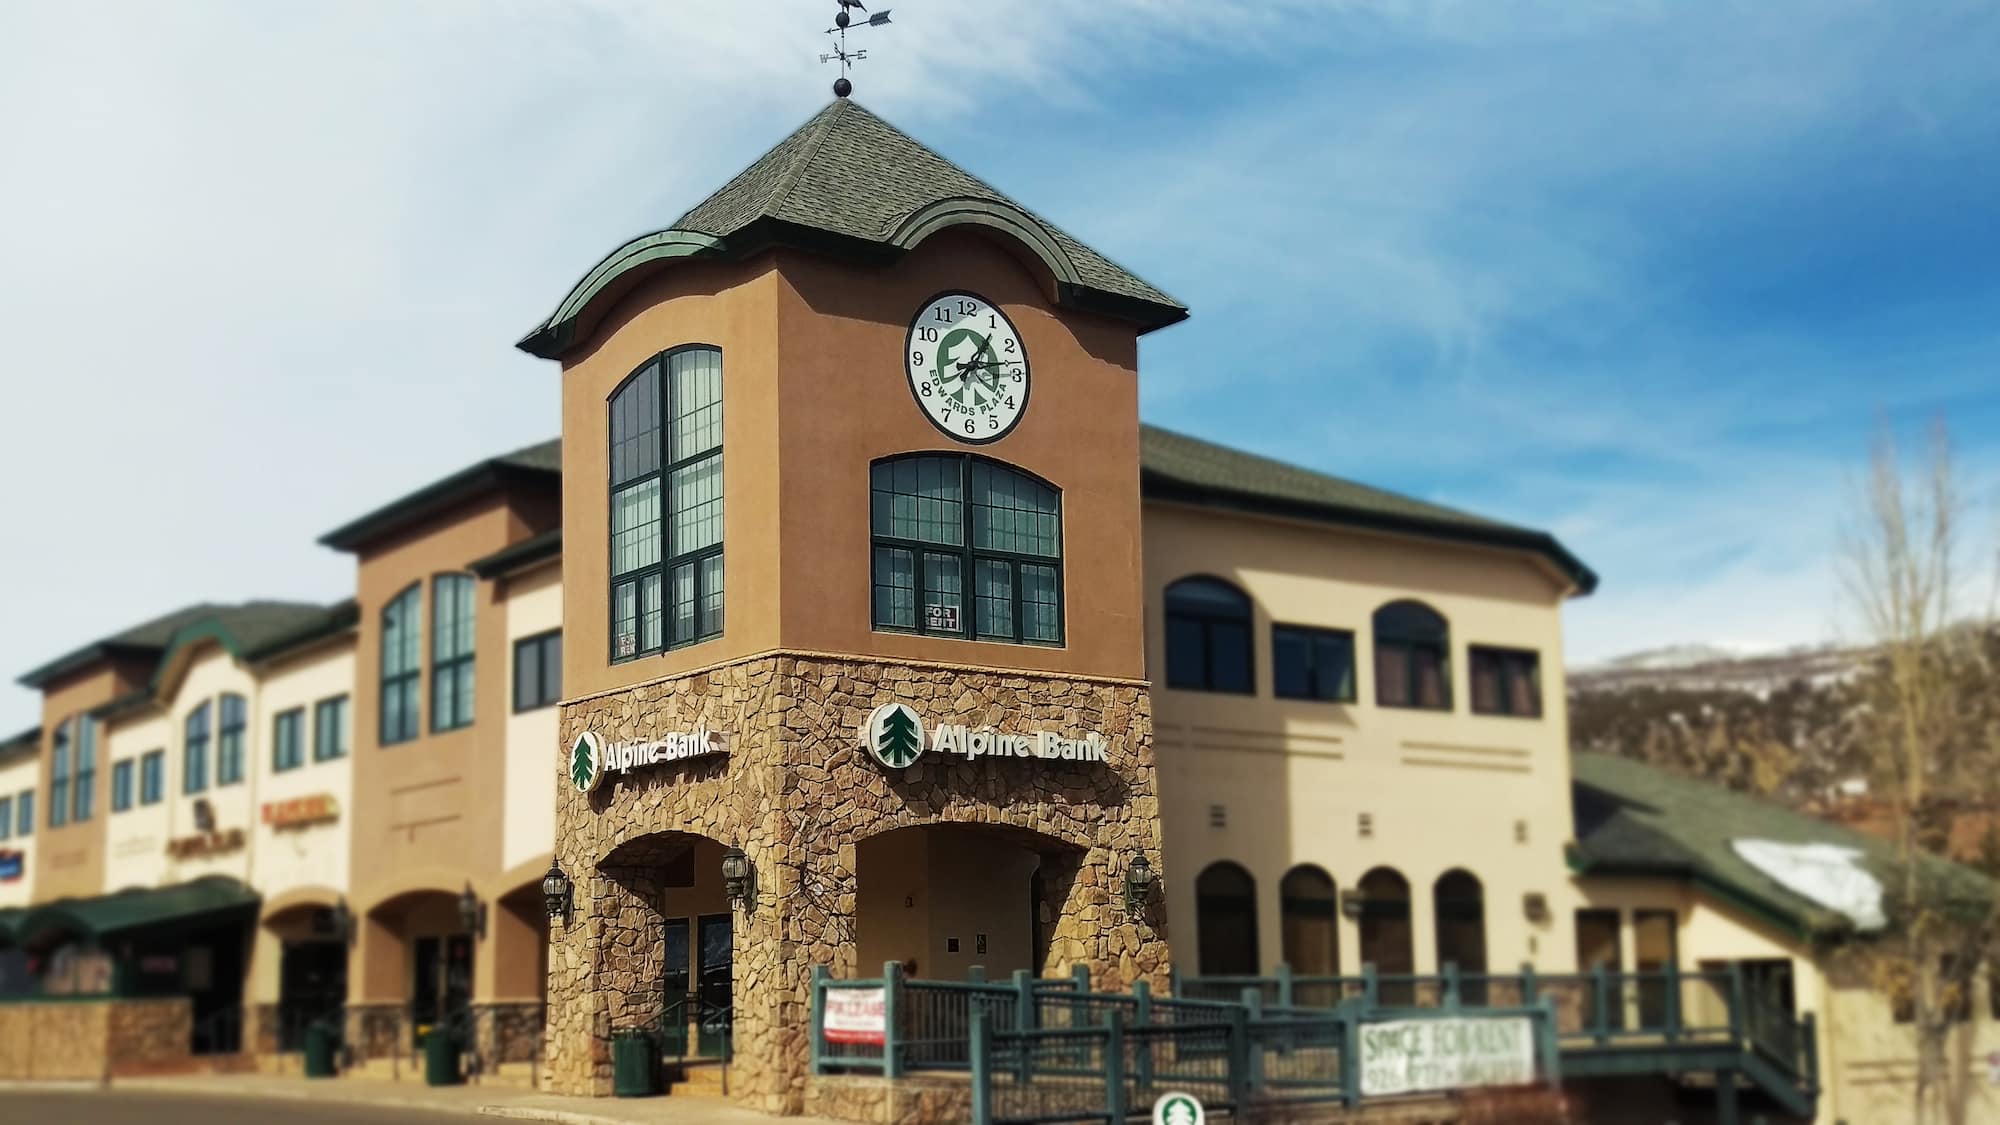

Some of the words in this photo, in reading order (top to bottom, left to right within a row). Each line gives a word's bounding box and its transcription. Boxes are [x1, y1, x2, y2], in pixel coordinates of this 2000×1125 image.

[857, 49, 867, 60] E
[934, 306, 953, 323] 11
[957, 300, 977, 316] 12
[988, 314, 997, 329] 1
[918, 326, 938, 343] 10
[1004, 338, 1015, 353] 2
[912, 351, 923, 366] 9
[1012, 368, 1022, 383] 3
[921, 382, 932, 397] 8
[929, 369, 975, 416] EDWARDS
[980, 384, 1006, 414] PLAZA
[1004, 395, 1015, 409] 4
[941, 408, 951, 422] 7
[989, 415, 999, 429] 5
[964, 419, 975, 433] 6
[925, 607, 951, 618] FOR
[604, 738, 660, 775] Alpine
[666, 724, 711, 761] Bank
[932, 723, 1030, 761] Alpine
[1037, 730, 1109, 762] Bank
